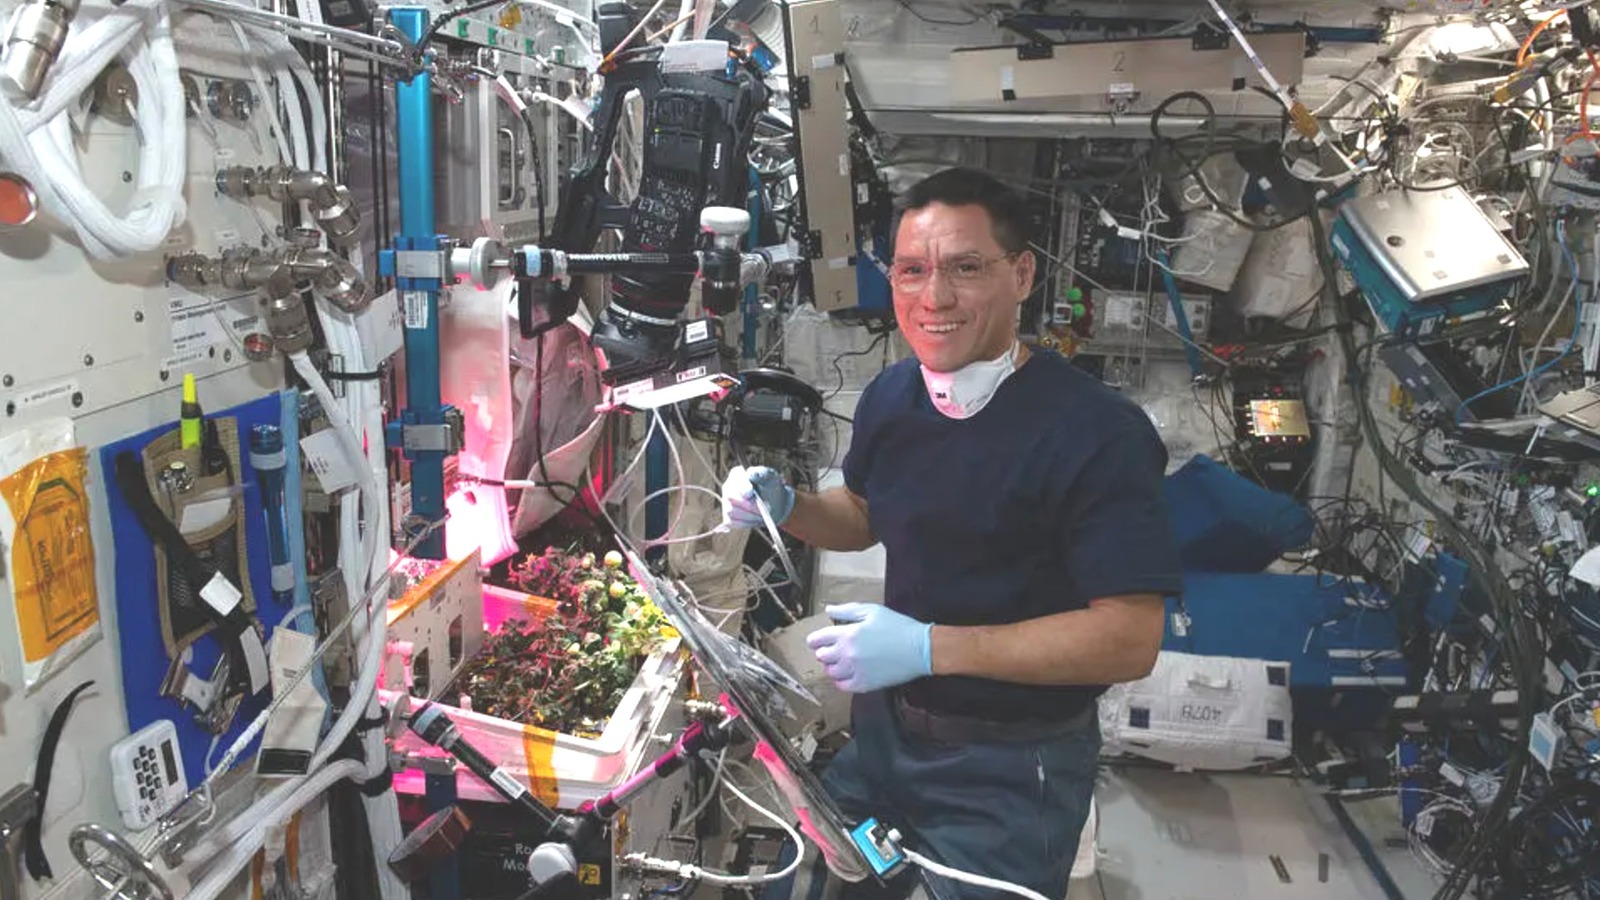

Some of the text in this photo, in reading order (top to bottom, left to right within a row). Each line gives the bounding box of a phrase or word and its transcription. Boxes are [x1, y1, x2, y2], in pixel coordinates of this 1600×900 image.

[1111, 51, 1125, 72] 2
[713, 142, 722, 170] Canon
[1182, 704, 1222, 721] 4078
